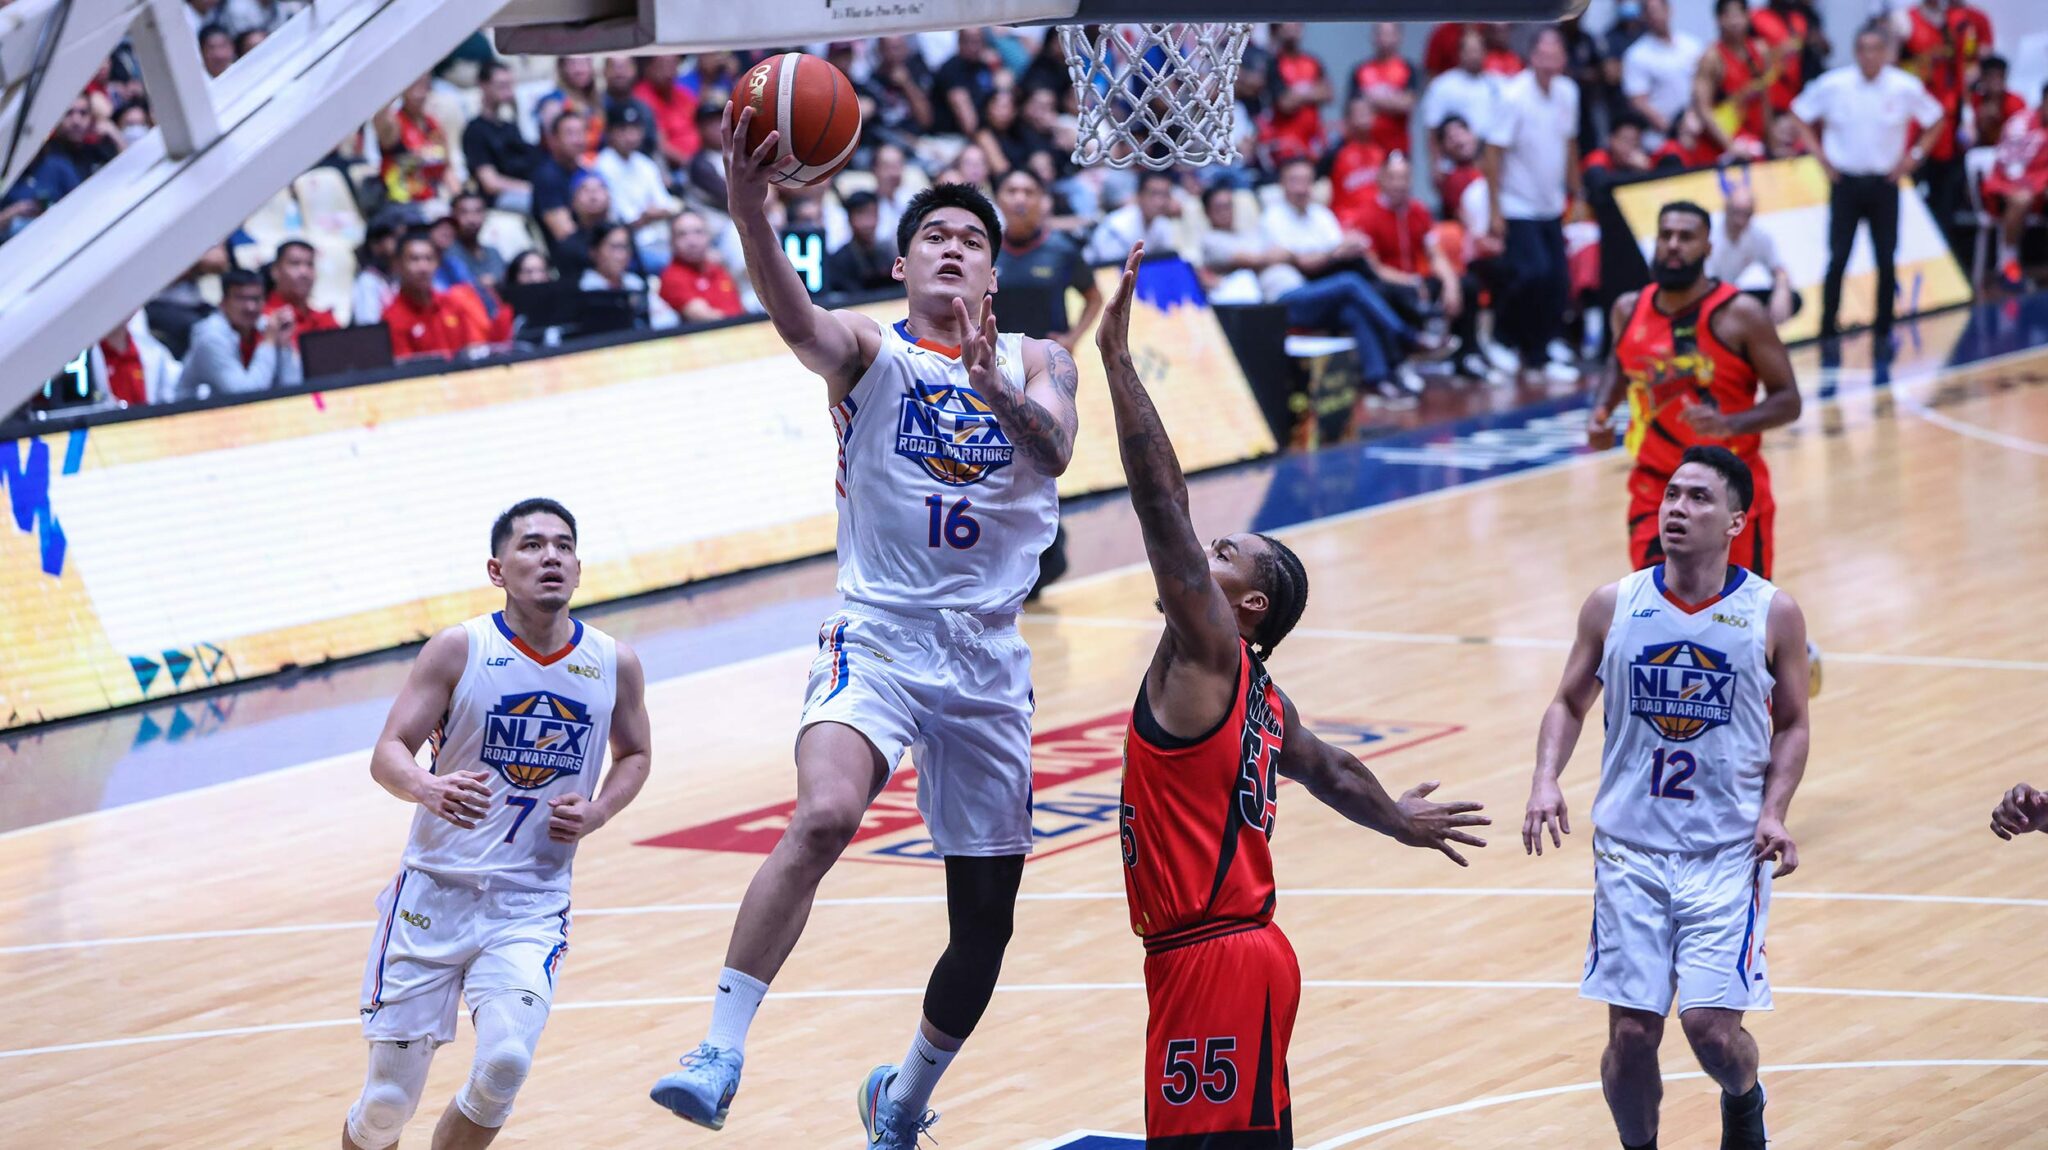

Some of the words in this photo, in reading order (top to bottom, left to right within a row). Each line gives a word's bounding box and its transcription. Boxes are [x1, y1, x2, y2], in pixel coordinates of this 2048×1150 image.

[785, 233, 823, 293] 4
[903, 400, 1010, 444] NLEX
[898, 436, 936, 454] ROAD
[942, 442, 1012, 462] WARRIORS
[925, 493, 981, 550] 16
[1633, 667, 1732, 705] NLEX
[1631, 699, 1662, 713] ROAD
[1665, 701, 1731, 721] WARRIORS
[488, 717, 588, 755] NLEX
[483, 746, 516, 763] ROAD
[518, 749, 583, 771] WARRIORS
[1650, 747, 1697, 801] 12
[503, 795, 539, 844] 7
[1161, 1036, 1239, 1106] 55
